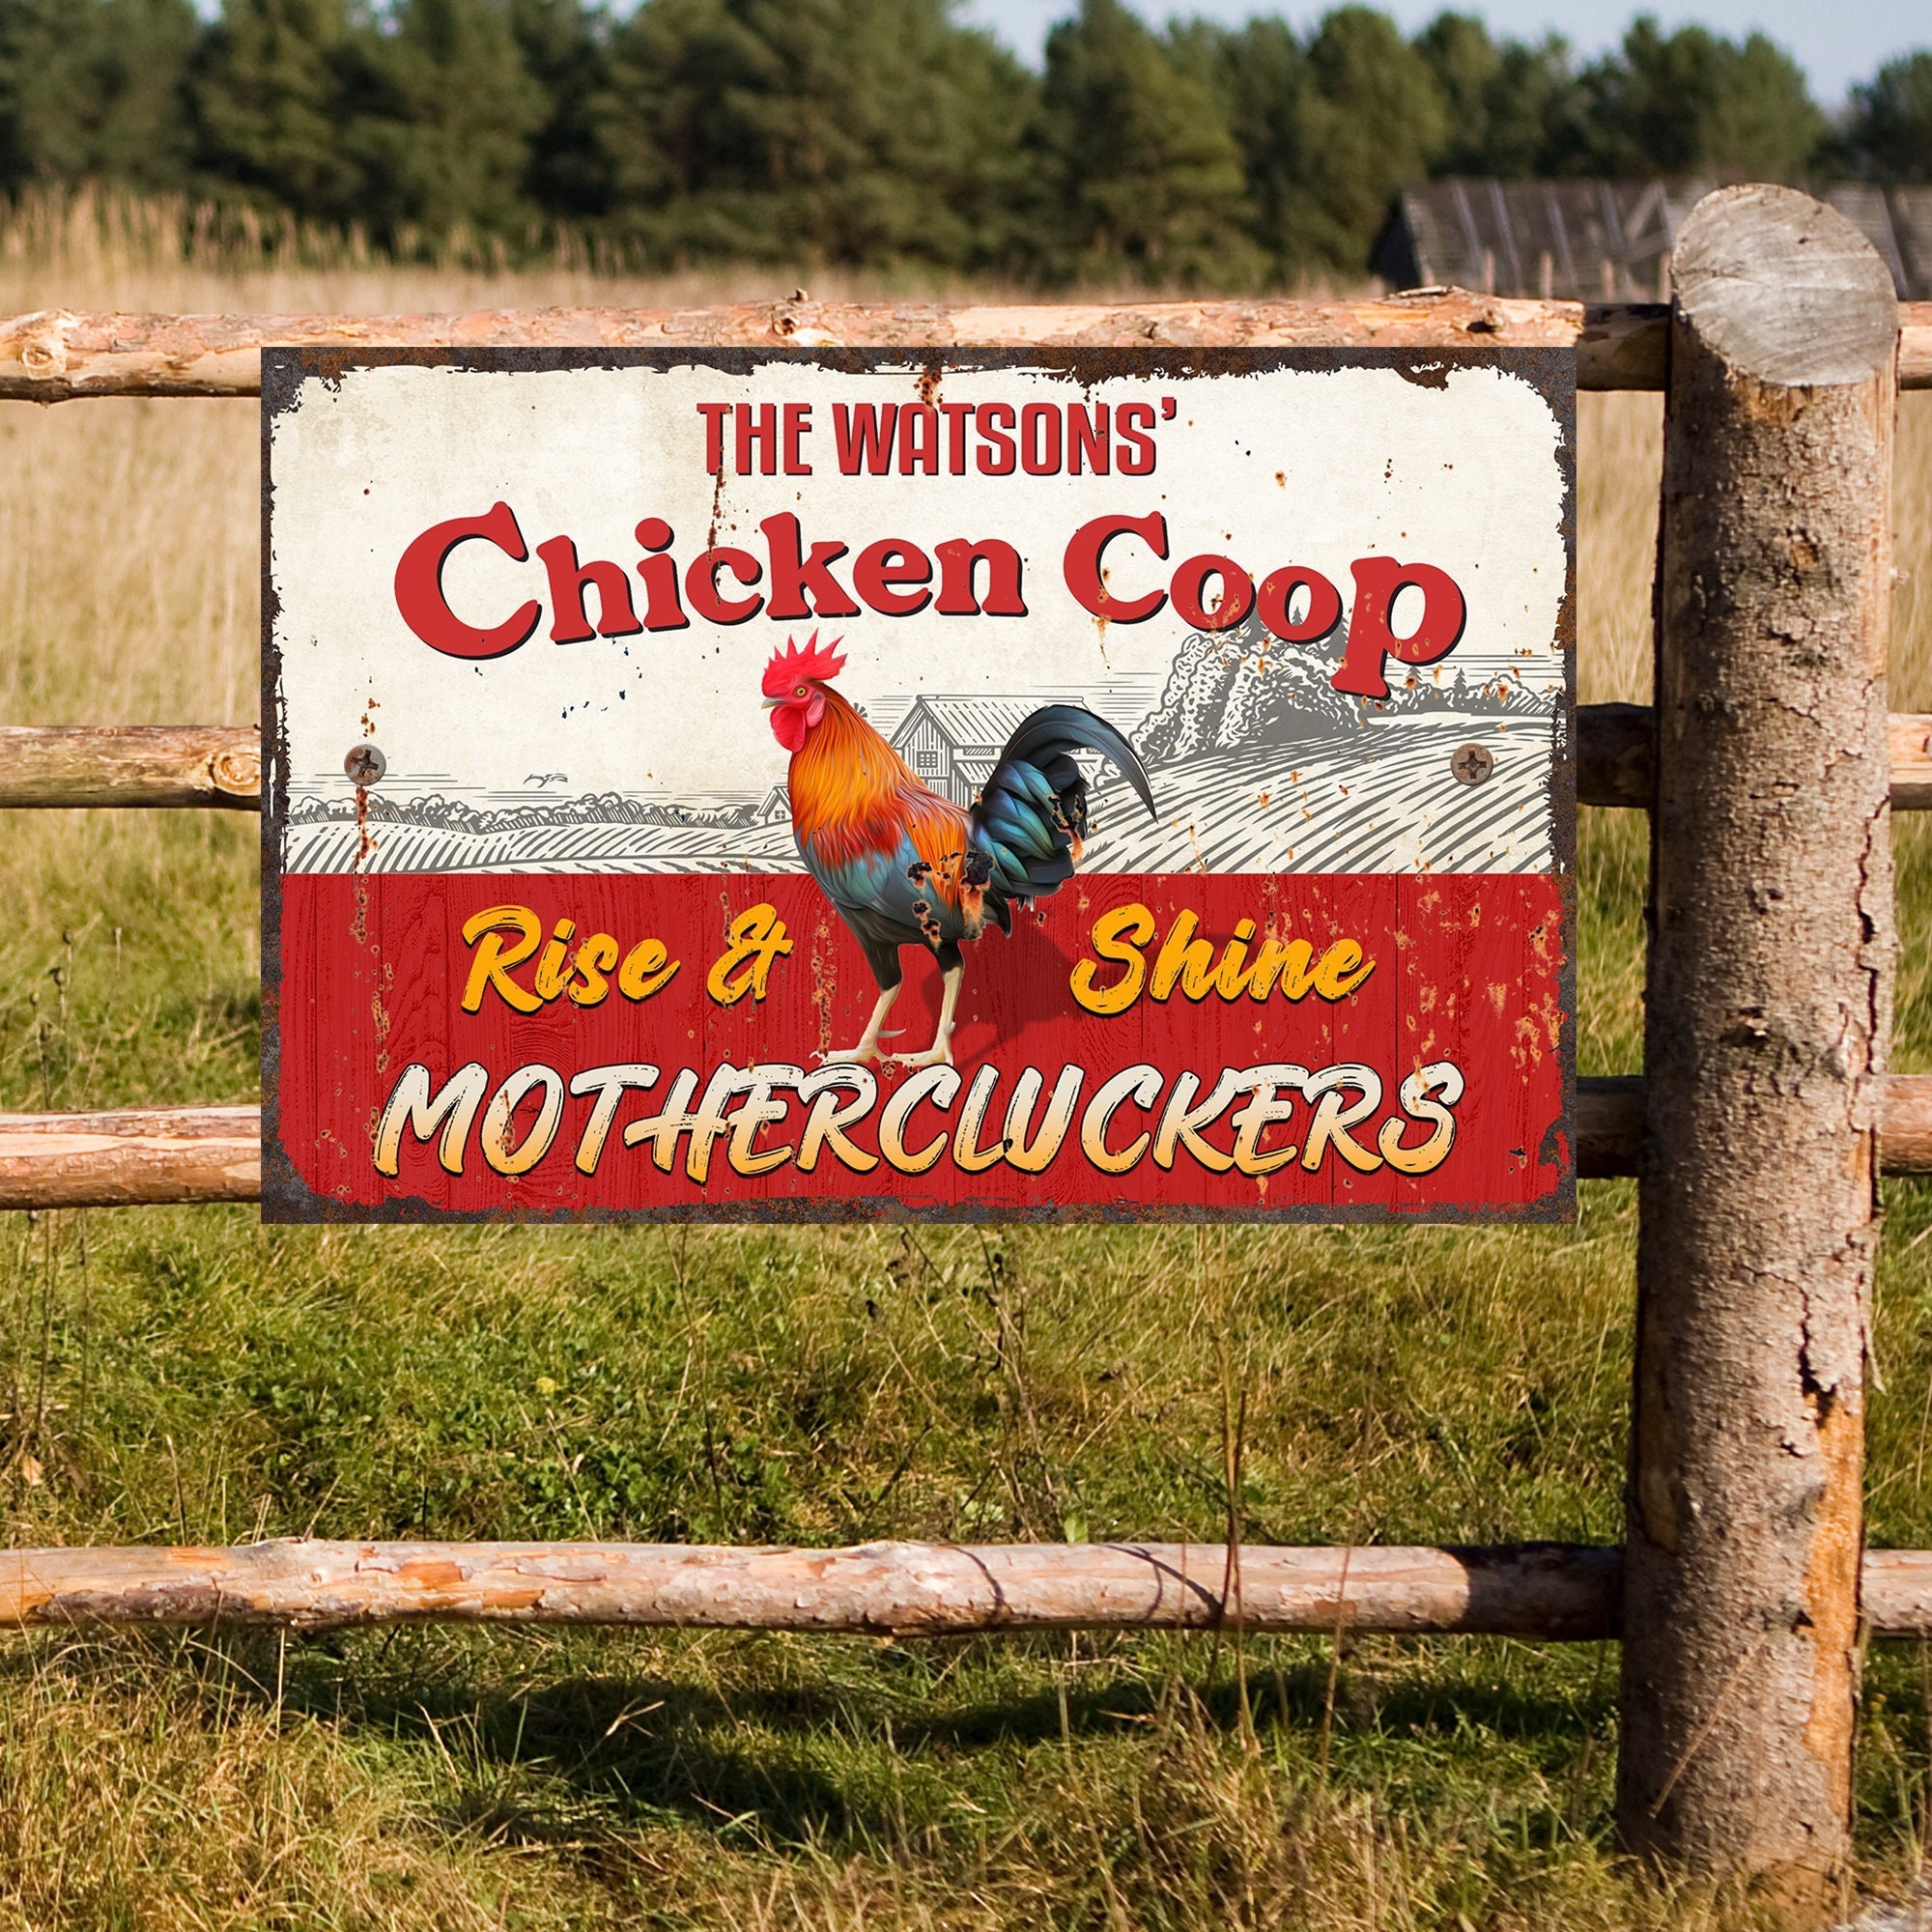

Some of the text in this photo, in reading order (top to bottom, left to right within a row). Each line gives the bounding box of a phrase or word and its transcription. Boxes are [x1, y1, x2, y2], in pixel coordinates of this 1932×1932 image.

[696, 403, 812, 476] THE
[394, 500, 1467, 700] Chicken Coop
[461, 902, 1377, 1015] Rise & Shine
[373, 1061, 1465, 1184] MOTHERCLUCKERS
